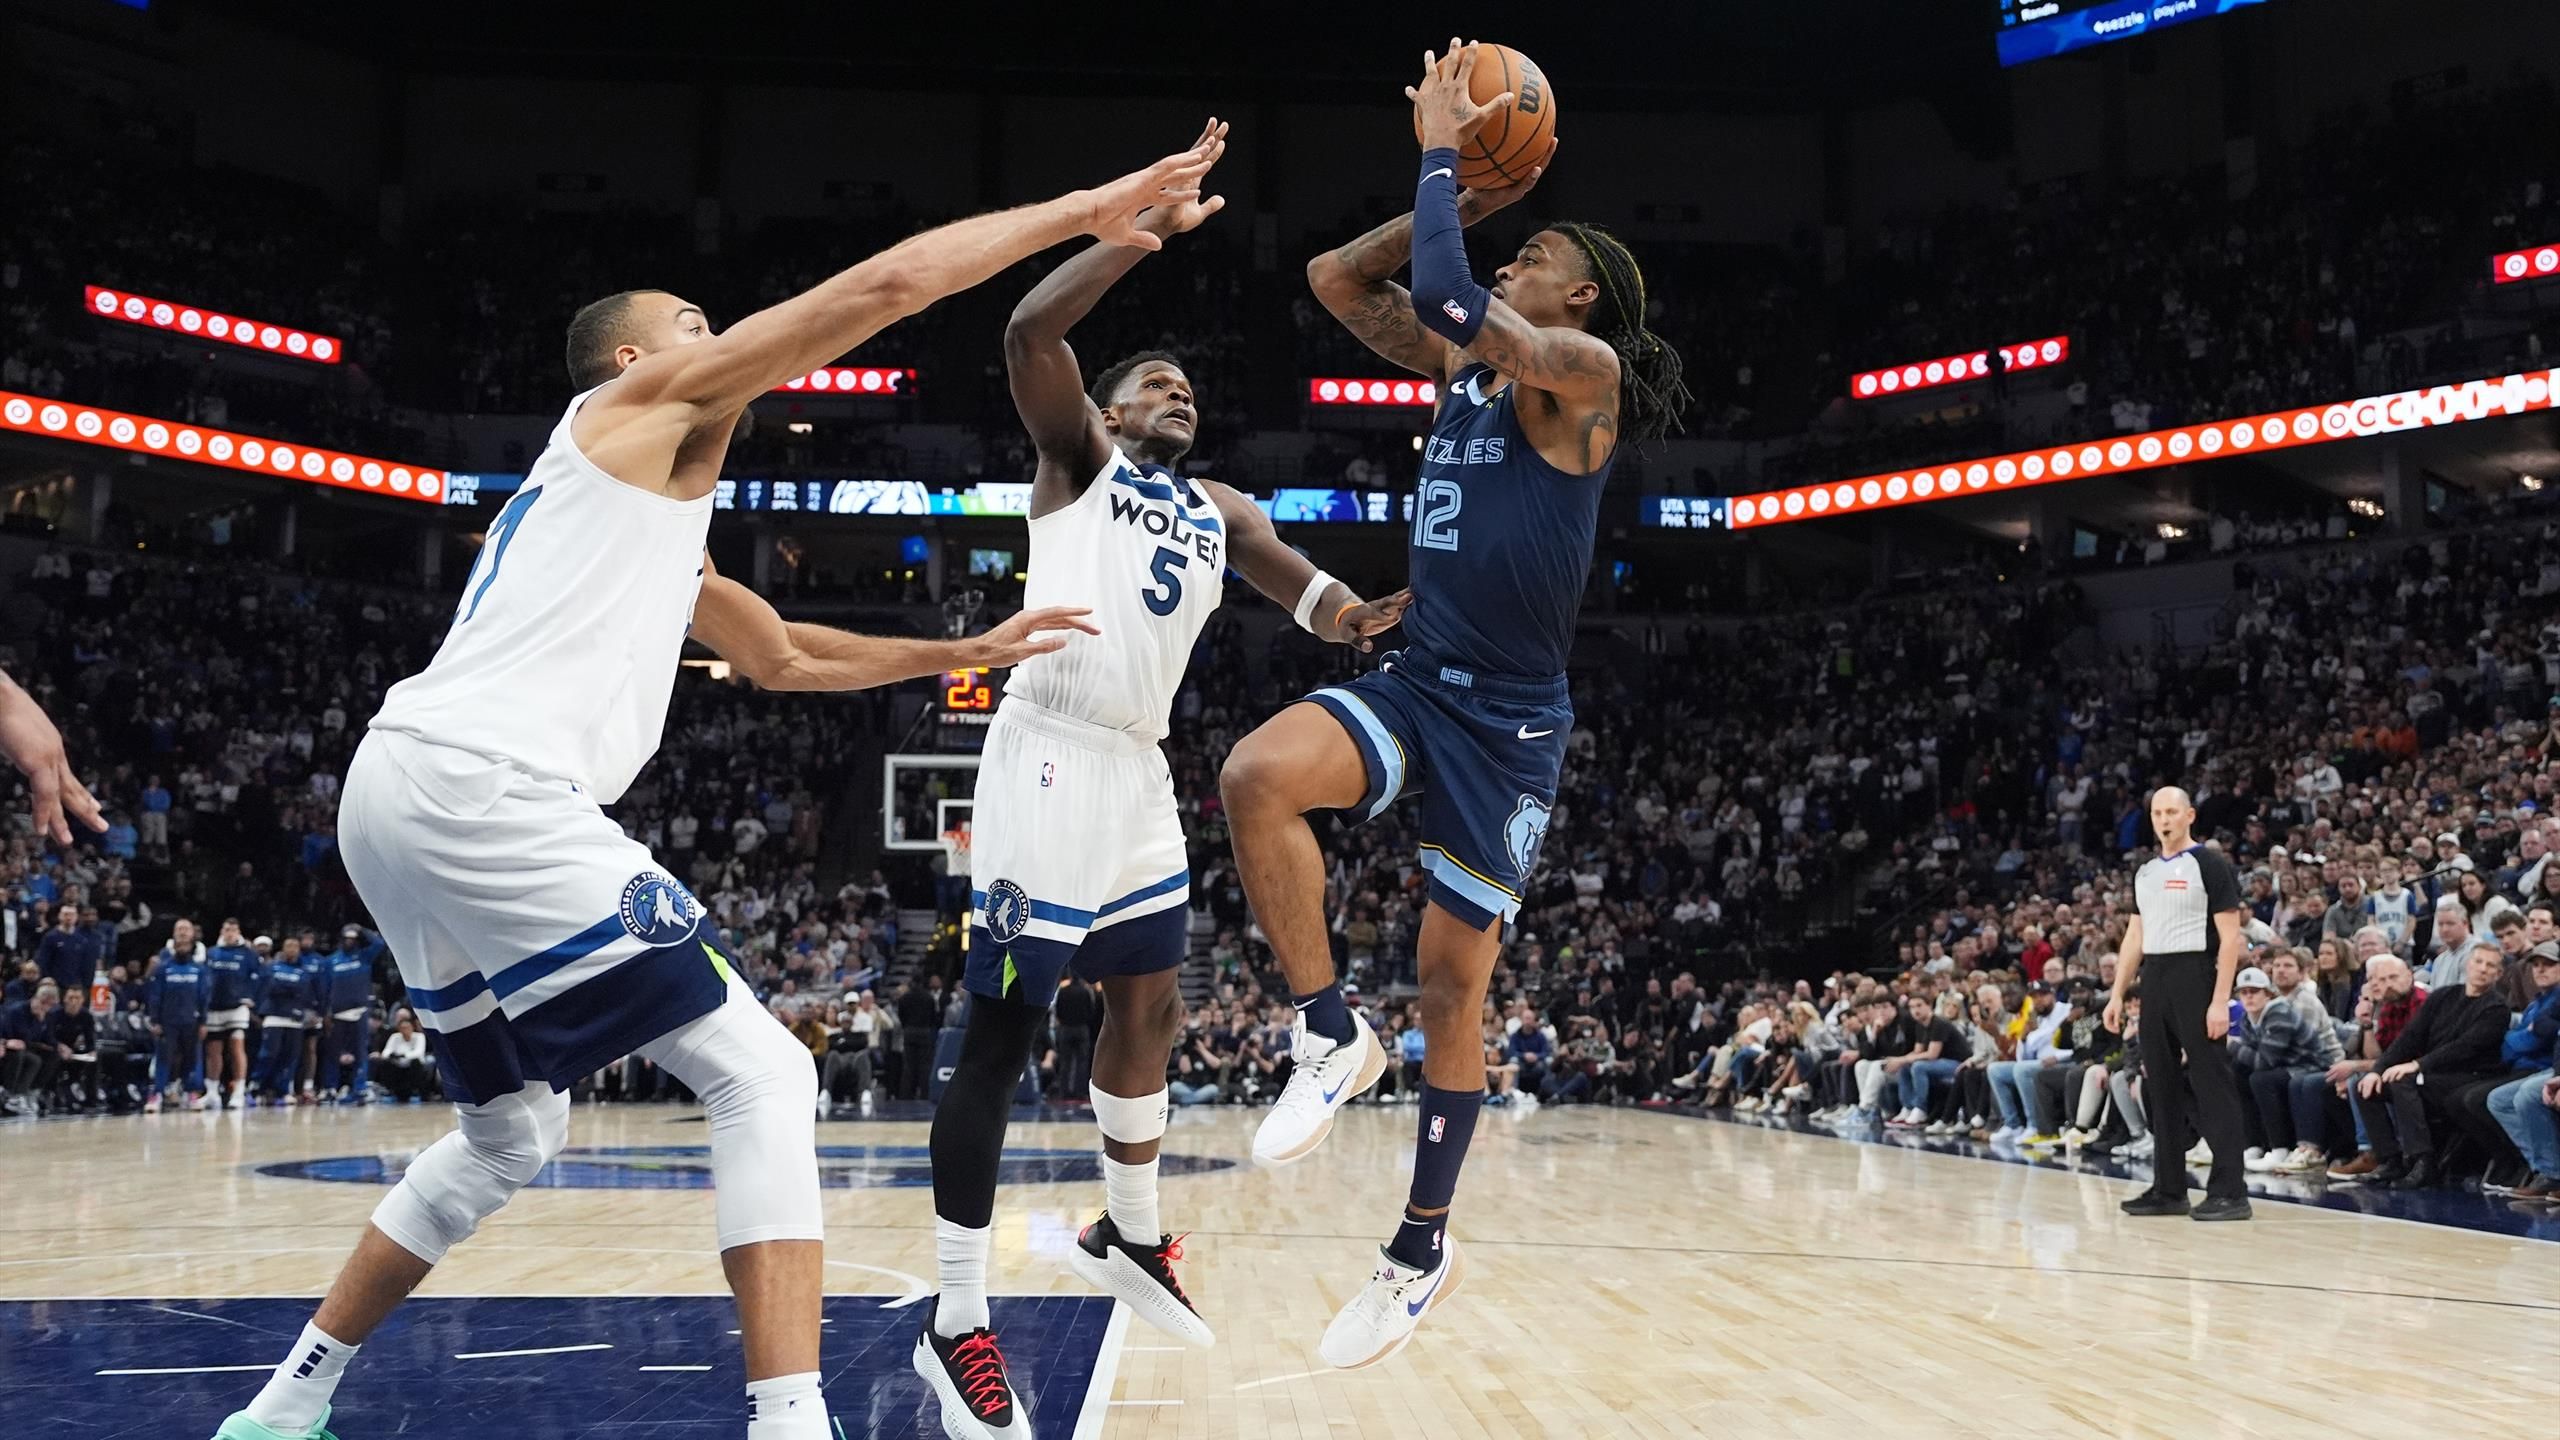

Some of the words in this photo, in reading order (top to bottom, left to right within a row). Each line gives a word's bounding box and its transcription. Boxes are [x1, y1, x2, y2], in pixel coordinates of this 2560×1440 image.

[450, 474, 480, 492] HOU
[450, 490, 479, 506] ATL
[1001, 493, 1032, 512] 12
[1413, 477, 1463, 552] 12
[1660, 498, 1687, 514] UTA
[452, 484, 544, 626] 7
[1141, 545, 1189, 617] 5
[948, 672, 989, 708] 2.9
[621, 879, 641, 936] MINNESOTA
[1003, 881, 1028, 933] TIMBERWOLVES
